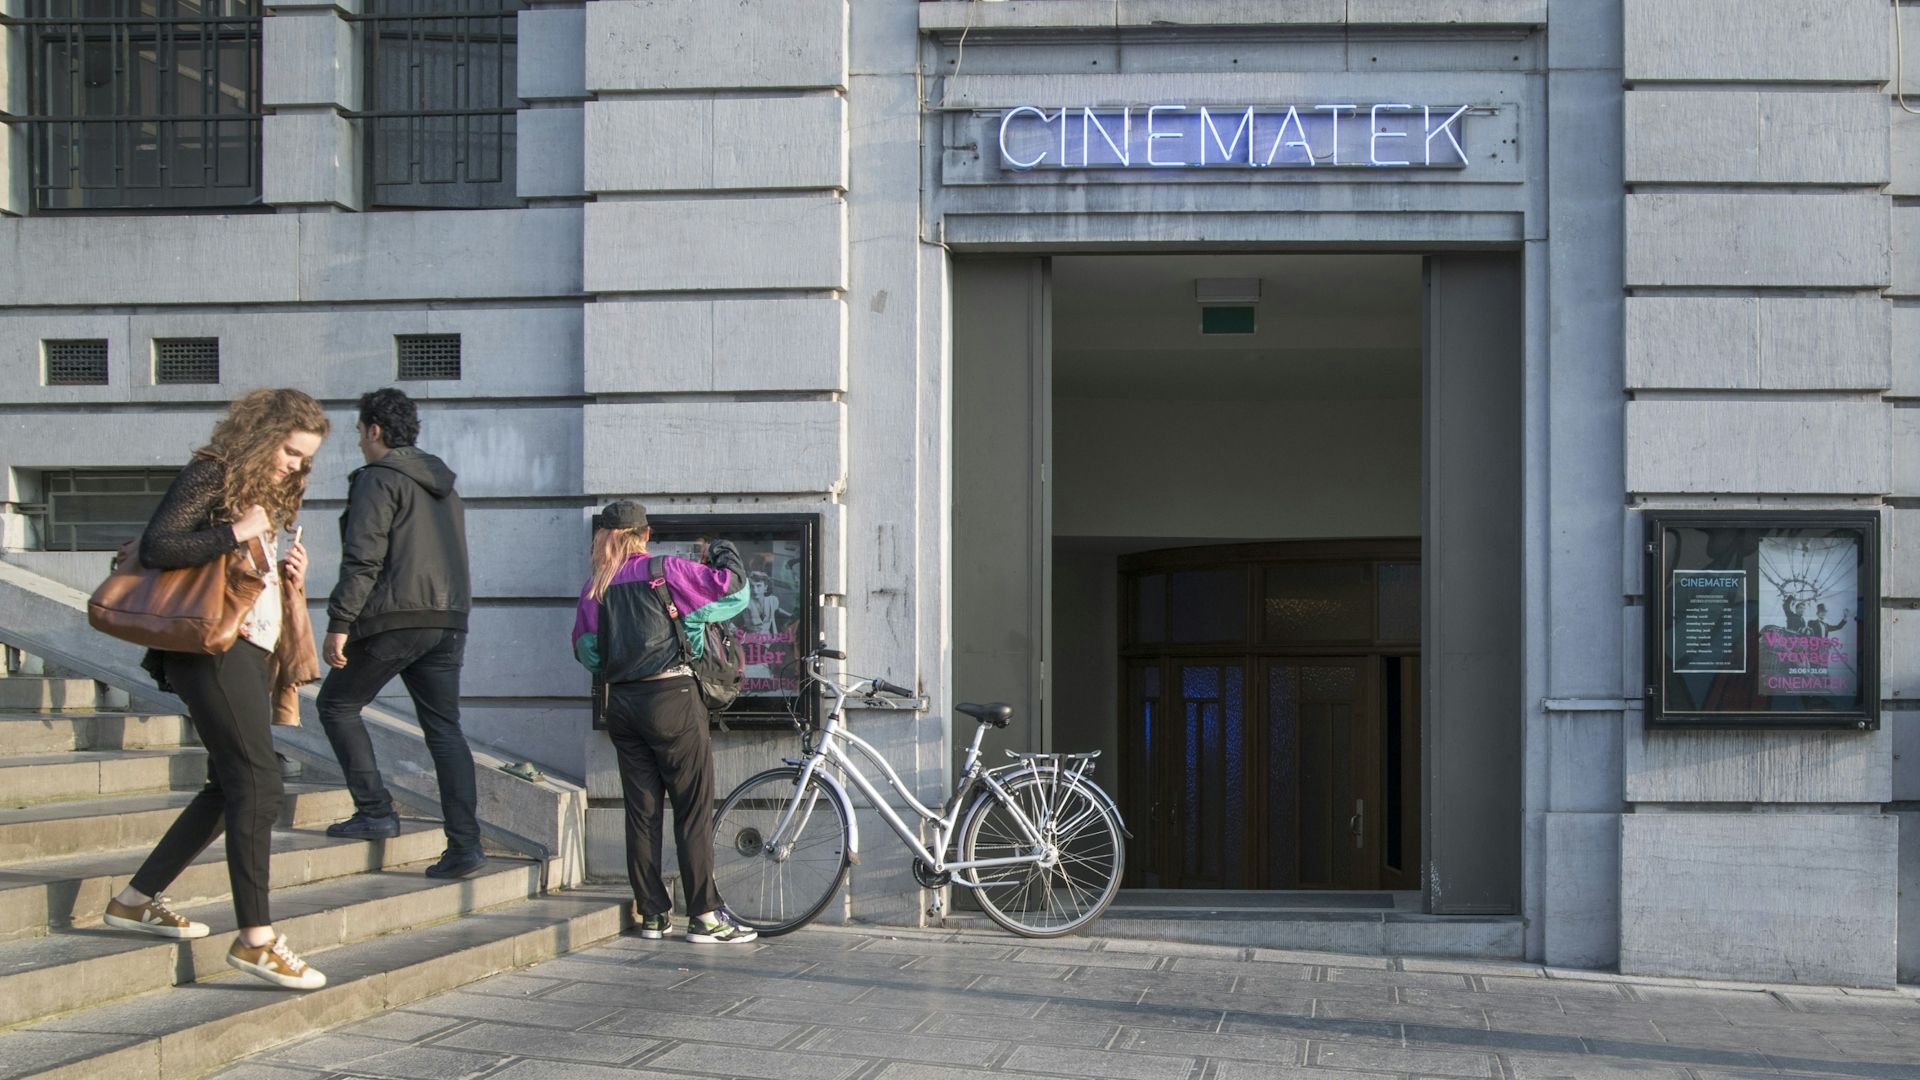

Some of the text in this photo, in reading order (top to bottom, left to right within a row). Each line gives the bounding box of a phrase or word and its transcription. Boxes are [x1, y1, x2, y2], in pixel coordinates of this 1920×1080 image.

[999, 104, 1469, 167] CINEMATEK
[1680, 577, 1739, 588] CINEMATEK
[735, 627, 793, 643] Samuel
[1763, 632, 1844, 651] Voyages,
[743, 644, 786, 664] ller
[1776, 651, 1849, 667] voyages
[742, 677, 796, 690] EMATEK
[1767, 675, 1849, 689] CINEMATEK
